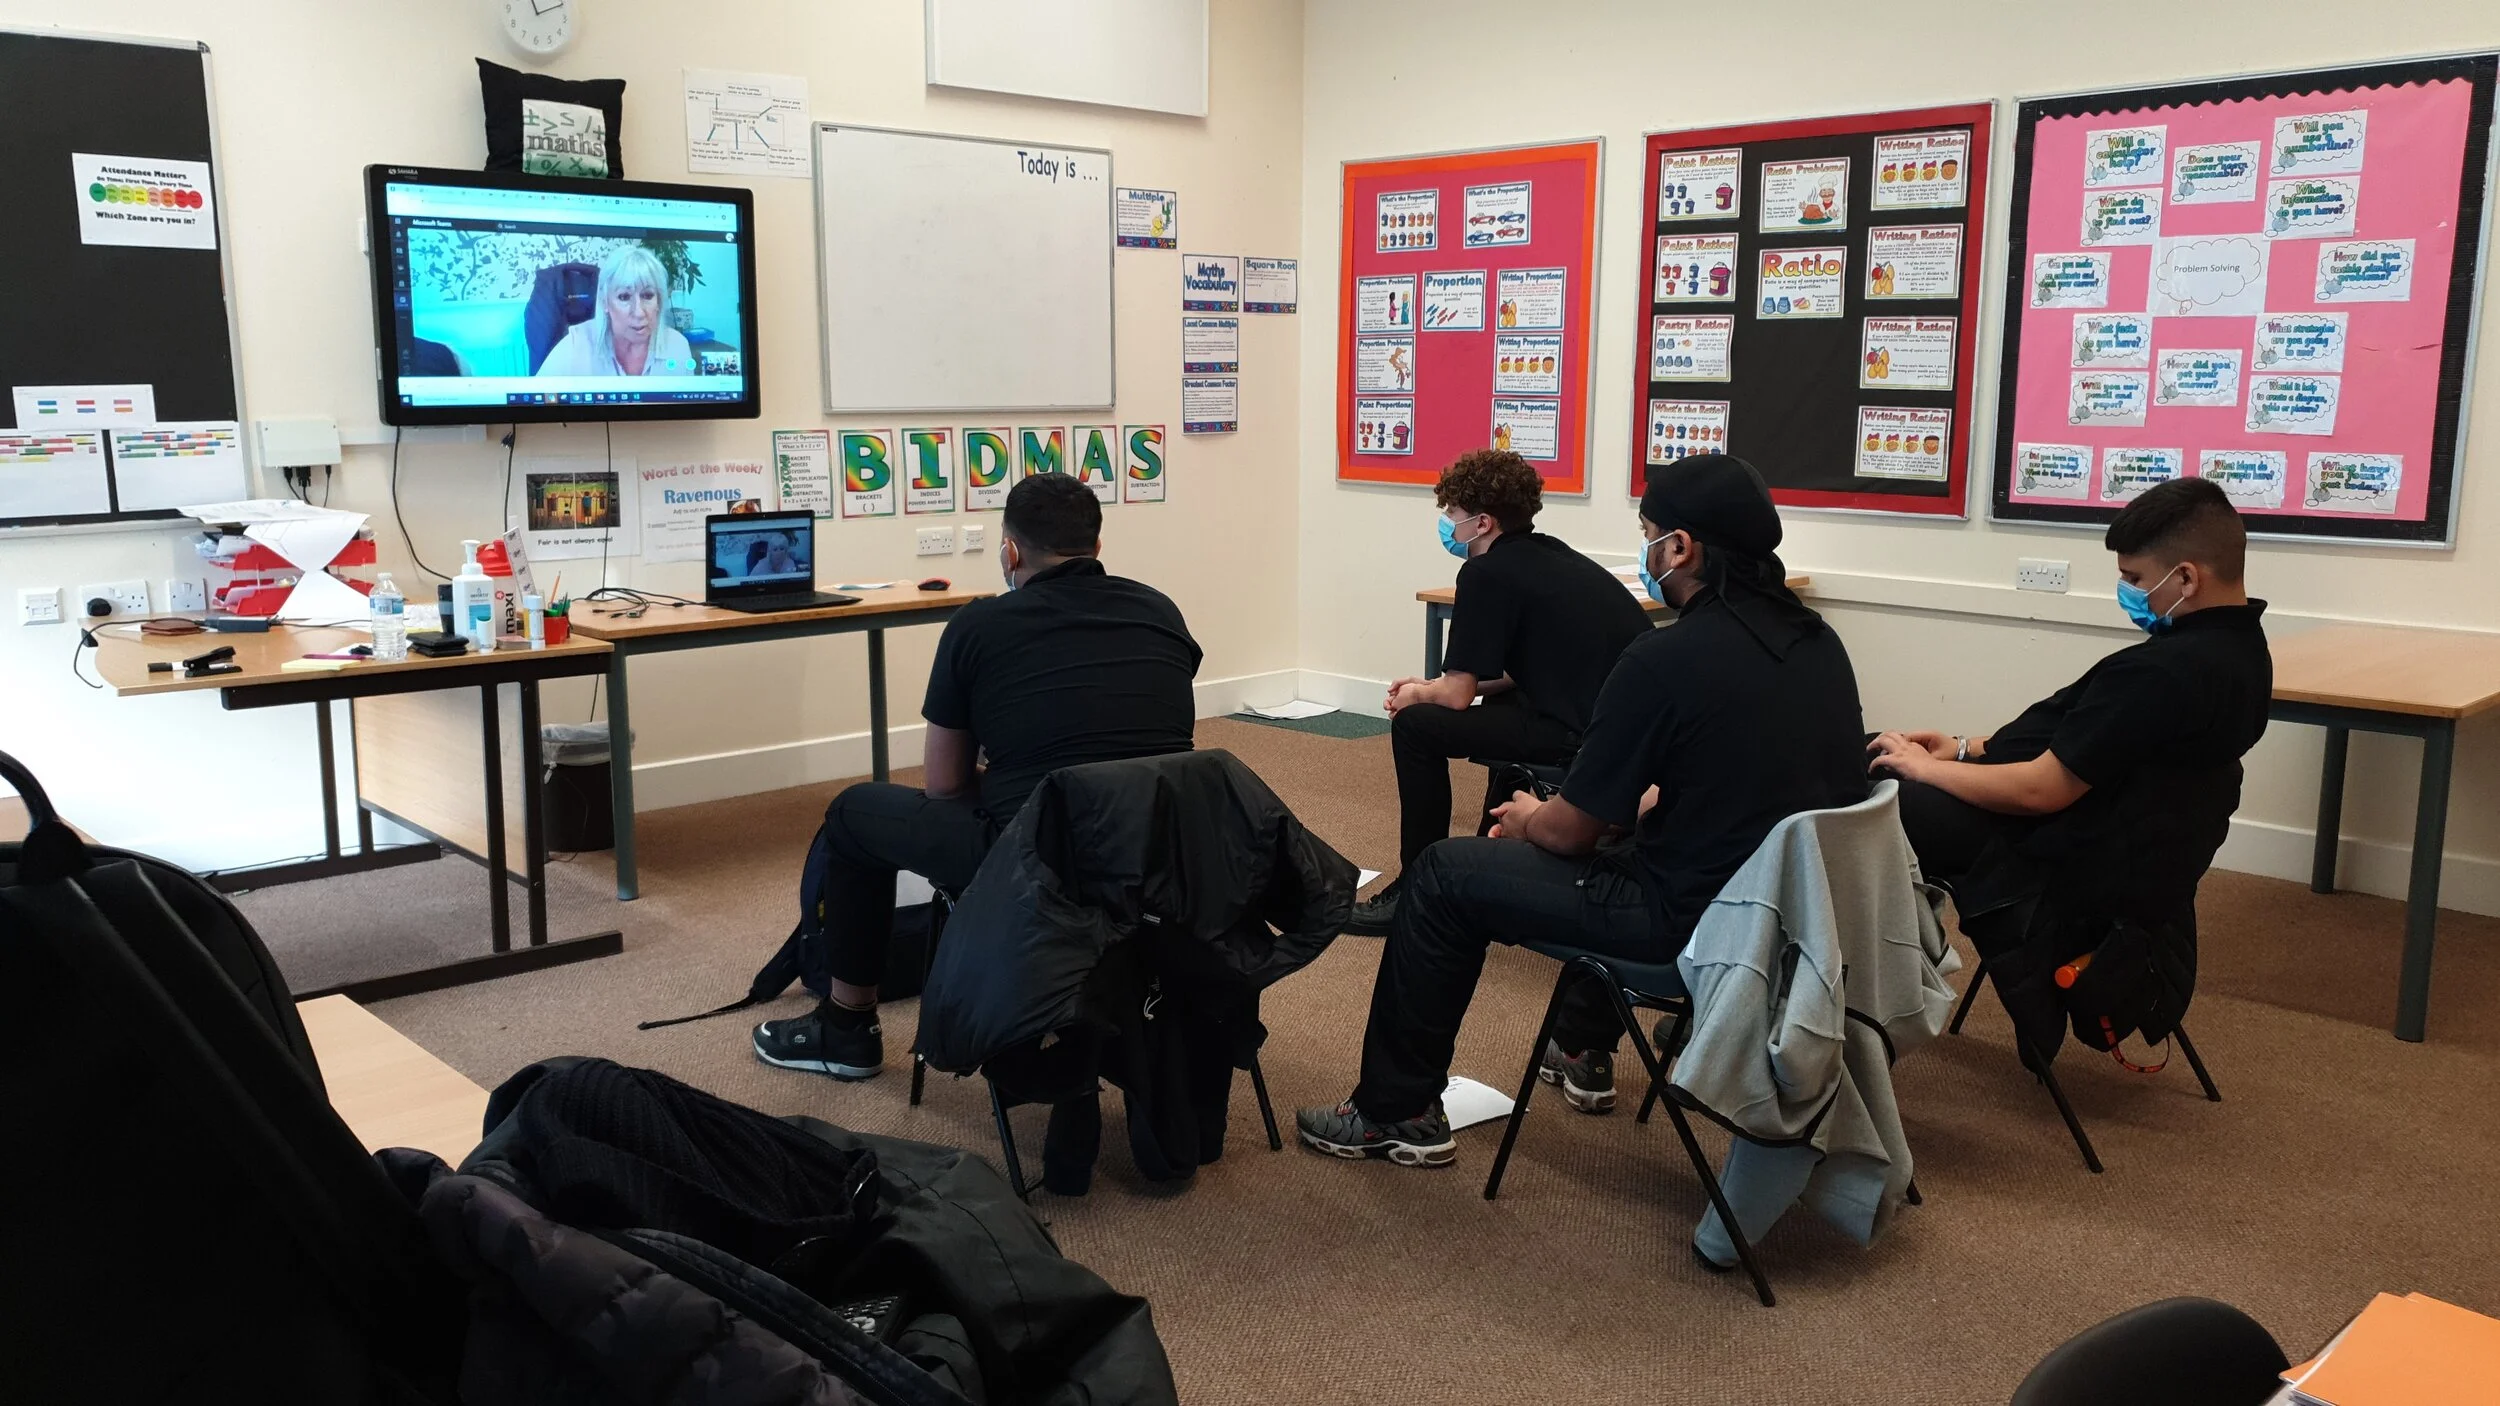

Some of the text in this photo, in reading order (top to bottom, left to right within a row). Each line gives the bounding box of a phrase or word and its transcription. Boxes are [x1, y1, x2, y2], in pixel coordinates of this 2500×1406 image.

[506, 4, 511, 12] 9
[511, 19, 516, 28] 8
[563, 15, 567, 23] 3
[521, 31, 527, 39] 7
[557, 28, 561, 36] 4
[534, 36, 539, 45] 6
[547, 36, 552, 44] 5
[2294, 121, 2344, 135] Will you
[2107, 136, 2145, 148] Will a
[2303, 133, 2333, 143] use a
[527, 133, 604, 158] maths
[1880, 137, 1964, 152] Writing Ratios
[2283, 138, 2354, 153] numberline?
[2096, 146, 2156, 160] calculator
[1666, 155, 1737, 169] Paint Ratios
[2109, 157, 2141, 172] help?
[2188, 154, 2242, 166] Does your
[101, 166, 187, 180] Attendance Matters
[1017, 151, 1059, 184] Today
[1066, 156, 1076, 178] is
[1767, 164, 1845, 176] Ratio Problems
[2180, 162, 2248, 172] answer seem
[2182, 169, 2245, 180] reasonable?
[160, 180, 176, 188] Every
[2296, 184, 2326, 195] What
[1129, 191, 1164, 203] Multiple
[1499, 186, 1528, 196] Proportion?
[1381, 195, 1397, 203] What's
[1407, 194, 1435, 202] Proportion?
[2099, 197, 2144, 207] What do
[2281, 192, 2343, 207] information
[96, 211, 124, 220] Which
[166, 216, 181, 224] you
[2098, 205, 2144, 218] you need
[2276, 204, 2345, 219] do you have?
[2092, 215, 2151, 229] to find out?
[1874, 230, 1958, 243] Writing Ratios
[1662, 239, 1733, 251] Paint Ratios
[2334, 250, 2400, 264] How did you
[1198, 262, 1225, 279] Maths
[1246, 260, 1296, 270] Square Root
[1763, 254, 1840, 278] Ratio
[2174, 264, 2240, 273] Problem Solving
[2330, 262, 2402, 273] tackle similar
[1426, 275, 1482, 290] Proportion
[1501, 272, 1563, 283] Writing Proportions
[2337, 272, 2391, 285] problems?
[1185, 275, 1237, 295] Vocabulary
[1658, 319, 1729, 333] Pastry Ratios
[1870, 321, 1951, 334] Writing Ratios
[2088, 322, 2137, 334] What facts
[1360, 340, 1386, 348] Proportion
[1499, 337, 1560, 348] Writing Proportions
[2083, 336, 2141, 352] do you have?
[2167, 360, 2230, 373] How did you
[2177, 370, 2218, 380] get your
[2178, 380, 2218, 389] answer?
[1376, 402, 1412, 410] Proportions
[1496, 402, 1556, 413] Writing Proportions
[1655, 404, 1725, 414] What's the Ratio?
[1864, 411, 1946, 425] Writing Ratios
[642, 463, 763, 481] Word of the Week!
[2321, 461, 2391, 473] What have
[2320, 470, 2384, 481] you found
[2320, 480, 2387, 493] out today?
[664, 488, 742, 504] Ravenous
[505, 593, 515, 634] maxi
